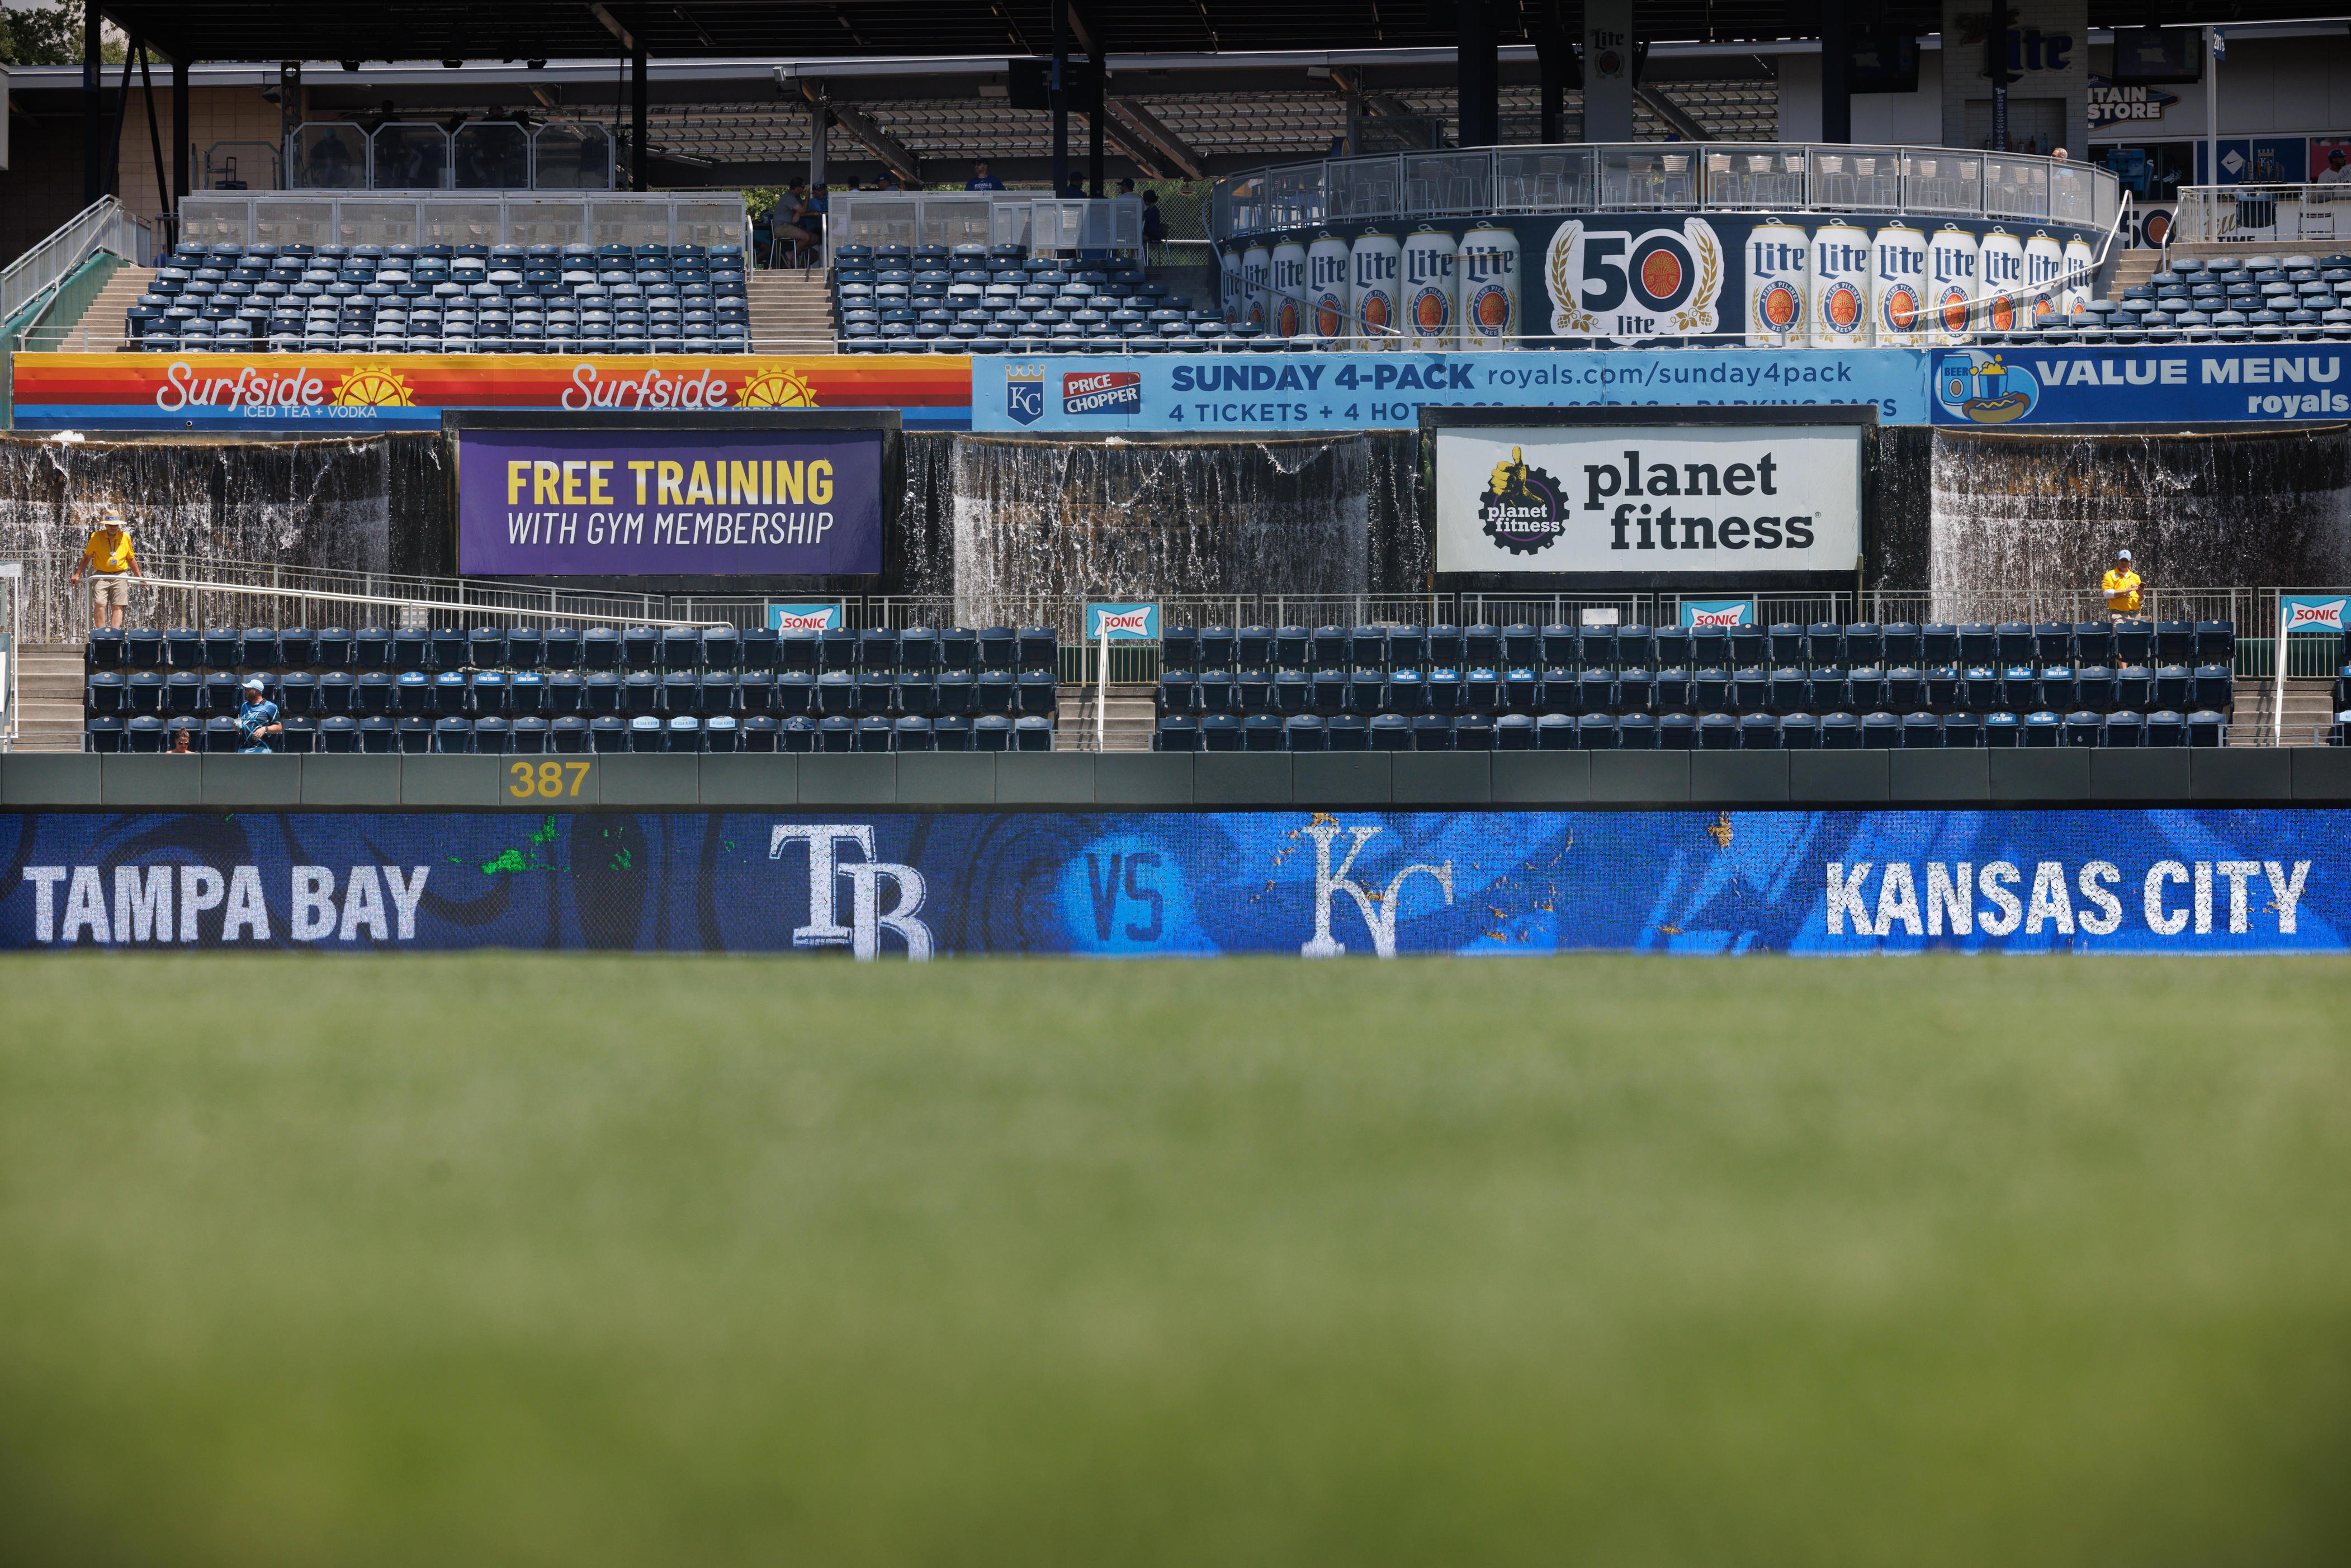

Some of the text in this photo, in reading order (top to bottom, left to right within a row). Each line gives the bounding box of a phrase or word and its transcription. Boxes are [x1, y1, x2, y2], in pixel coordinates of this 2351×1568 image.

[1594, 31, 1624, 50] Lite
[2088, 102, 2161, 120] STORE
[1310, 255, 1346, 292] Lite
[1355, 252, 1397, 289] Lite
[1407, 249, 1454, 286] Lite
[1467, 246, 1515, 283] Lite
[1582, 235, 1695, 312] 50
[1753, 241, 1805, 279] Lite
[1818, 242, 1867, 280] Lite
[1878, 244, 1924, 282] Lite
[1933, 247, 1975, 284] Lite
[1984, 249, 2020, 287] Lite
[2027, 253, 2059, 291] Lite
[1274, 260, 1303, 293] Lite
[1364, 292, 1373, 306] FINE
[1374, 291, 1391, 311] PILSNER
[1416, 289, 1427, 302] FINE
[1428, 288, 1447, 309] PILSNER
[1477, 287, 1489, 301] FINE
[1763, 282, 1776, 296] FINE
[1778, 282, 1799, 304] PILSNER
[1827, 283, 1841, 297] FINE
[1842, 283, 1861, 305] PILSNER
[1888, 285, 1899, 299] FINE
[1900, 284, 1918, 307] PILSNER
[1943, 287, 1952, 302] FINE
[1954, 287, 1970, 309] PILSNR
[1616, 315, 1655, 336] lite
[1068, 373, 1113, 394] PRICE
[1171, 361, 1852, 391] SUNDAY 4-PACK royals.com/sunday4pack
[1944, 367, 1969, 376] BEER
[2035, 357, 2340, 386] VALUE MENU
[156, 361, 324, 412] Surfside
[561, 363, 728, 411] Surfside
[1010, 386, 1041, 415] KC
[1067, 387, 1138, 413] CHOPPER
[244, 405, 276, 418] ICED
[283, 405, 311, 418] TEA
[328, 405, 377, 418] VODKA
[1169, 404, 1184, 422] 4
[1195, 402, 1308, 422] TICKETS
[1344, 403, 1360, 421] 4
[2248, 389, 2349, 418] royals
[508, 458, 834, 505] FREE TRAINING
[1584, 451, 1777, 510] planet
[1487, 503, 1548, 522] planet
[1495, 517, 1560, 533] fitness
[1610, 504, 1814, 549] fitness
[507, 511, 834, 544] WITH GYM MEMBERSHIP
[783, 617, 826, 629] SONIC
[1104, 617, 1144, 628] SONIC
[1695, 614, 1737, 627] SONIC
[2295, 609, 2338, 621] SONIC
[509, 761, 590, 798] 387
[22, 865, 431, 943] TAMPA BAY
[1085, 852, 1163, 942] VS
[1826, 859, 2311, 935] KANSAS CITY
